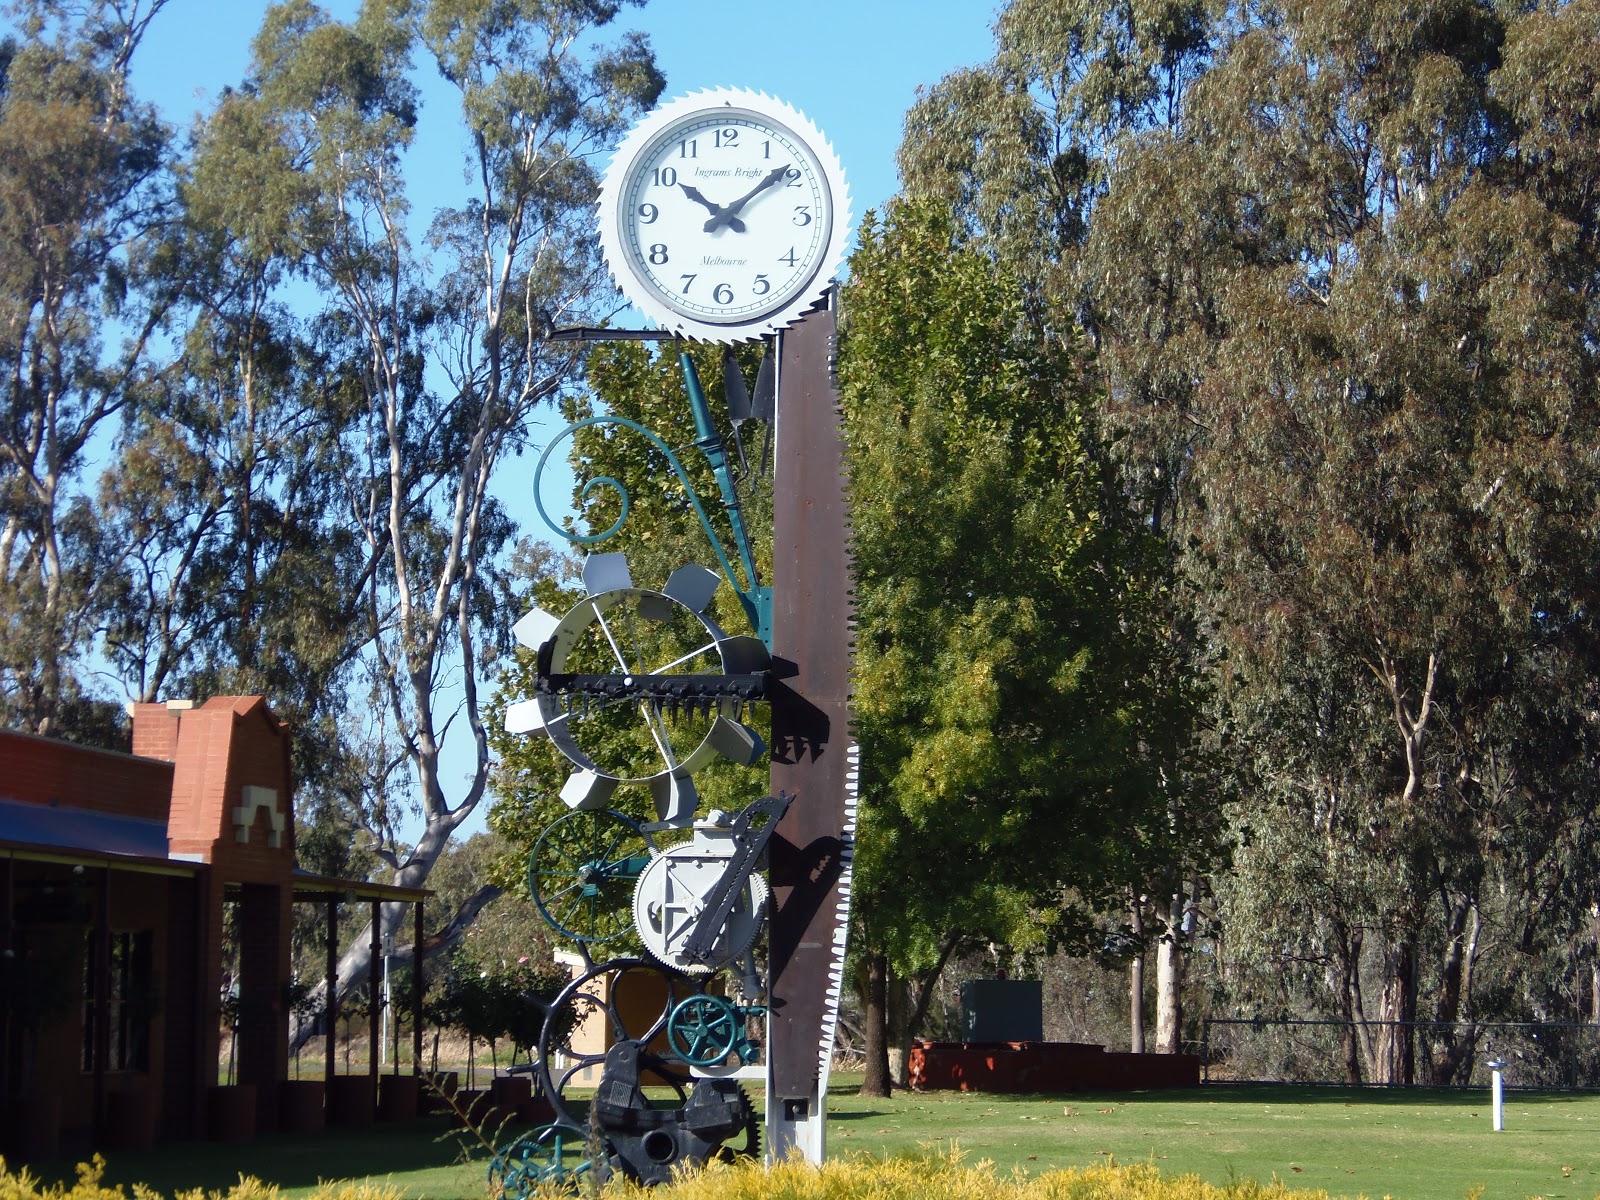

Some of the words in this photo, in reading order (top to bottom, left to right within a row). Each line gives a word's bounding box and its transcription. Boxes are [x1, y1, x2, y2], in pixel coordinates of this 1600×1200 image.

[712, 128, 739, 148] 12
[677, 140, 698, 158] 11
[761, 140, 770, 159] 1
[651, 167, 677, 187] 10
[694, 166, 732, 179] Ingrams
[785, 168, 803, 188] 2
[638, 203, 659, 224] 9
[792, 206, 811, 226] 3
[649, 244, 669, 265] 8
[700, 256, 748, 266] Melbourne
[777, 246, 800, 267] 4
[680, 274, 698, 294] 7
[713, 283, 734, 304] 6
[752, 274, 770, 295] 5
